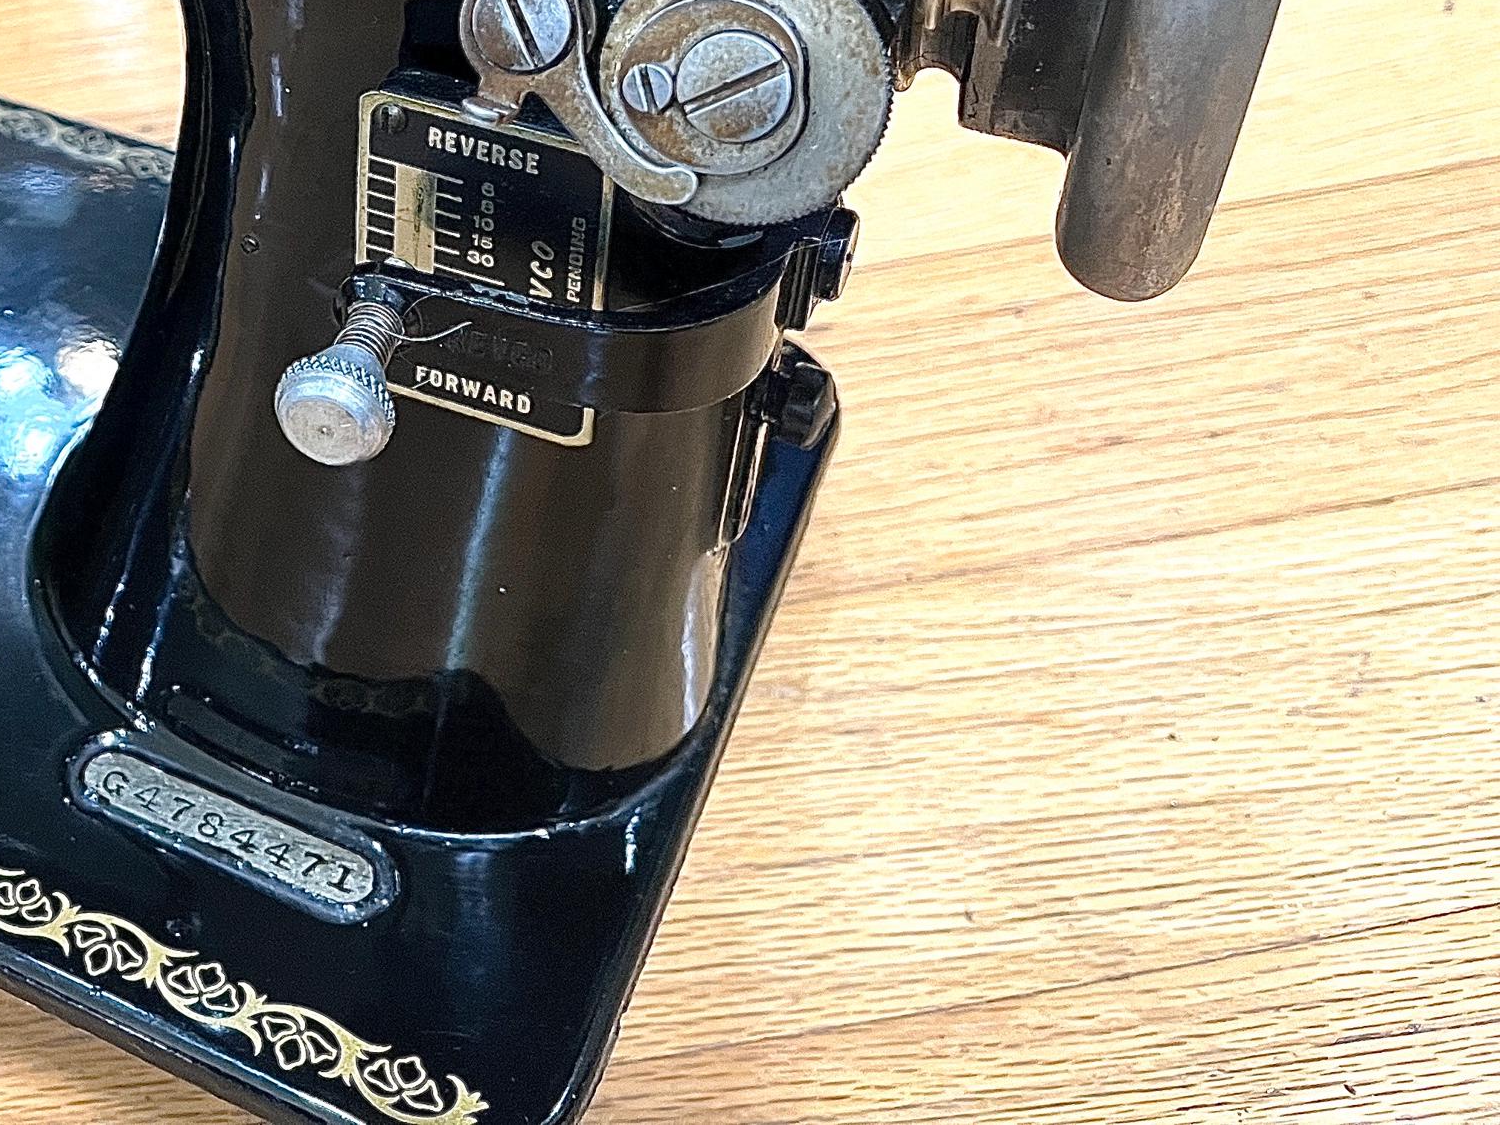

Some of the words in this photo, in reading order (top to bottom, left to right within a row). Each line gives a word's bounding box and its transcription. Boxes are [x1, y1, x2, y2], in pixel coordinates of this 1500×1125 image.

[428, 126, 539, 175] REVERSE
[471, 234, 493, 249] 15
[473, 215, 494, 231] 10
[466, 250, 494, 267] 30
[566, 217, 586, 303] PENDING
[416, 366, 531, 414] FORWARD
[102, 770, 356, 894] G4784471
